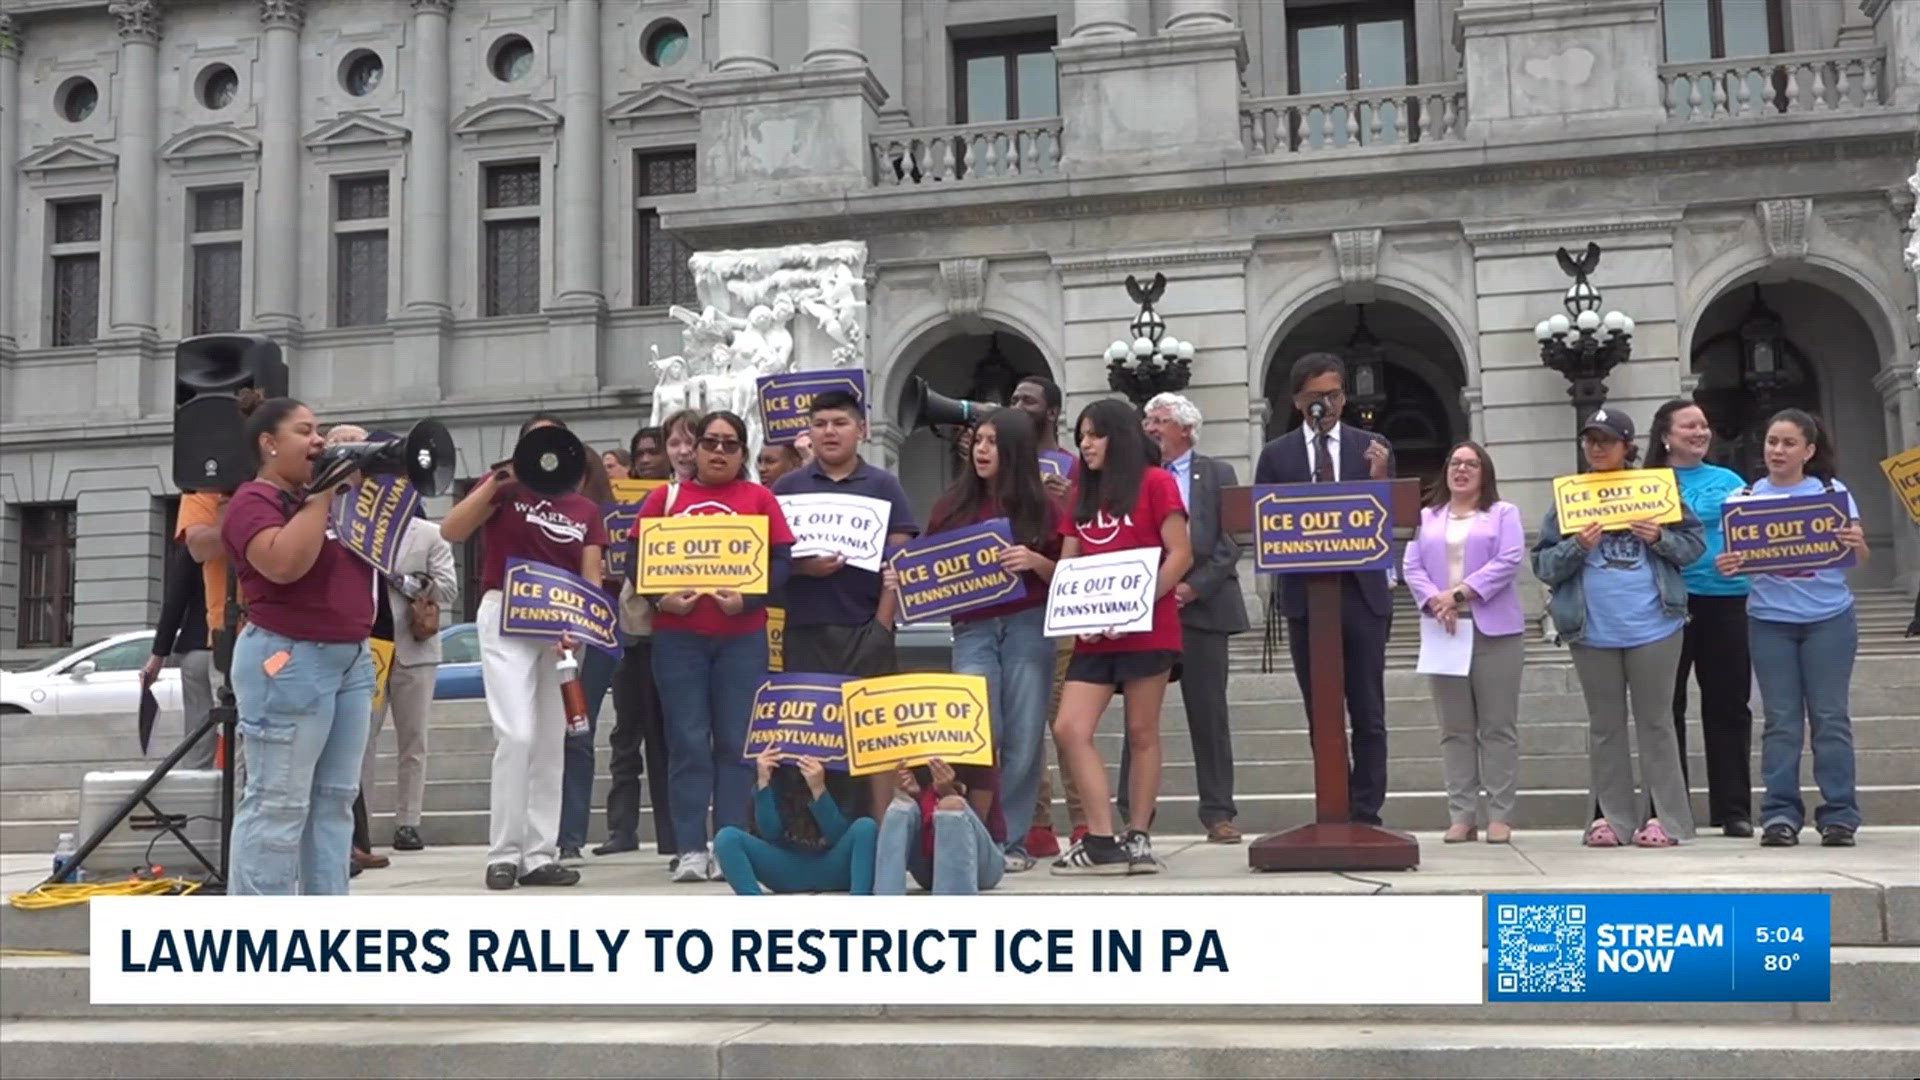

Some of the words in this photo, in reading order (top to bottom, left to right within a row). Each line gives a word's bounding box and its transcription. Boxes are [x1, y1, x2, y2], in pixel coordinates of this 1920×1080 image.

[766, 396, 789, 411] ICE
[355, 477, 379, 518] OUT
[1565, 490, 1591, 504] ICE
[1597, 486, 1633, 500] OUT
[1639, 484, 1661, 495] OF
[1567, 500, 1665, 519] PENNSYLVANIA
[808, 513, 843, 525] OUT
[851, 516, 872, 531] OF
[1263, 514, 1294, 531] ICE
[1300, 511, 1342, 530] OUT
[1348, 510, 1375, 527] OF
[1731, 525, 1760, 541] ICE
[1765, 520, 1805, 539] OUT
[1811, 516, 1836, 534] OF
[351, 519, 367, 550] ICE
[648, 540, 676, 556] ICE
[683, 539, 721, 556] OUT
[728, 540, 753, 555] OF
[1263, 538, 1376, 555] PENNSYLVANIA
[1741, 541, 1839, 560] ENNSYLVANIA
[647, 564, 753, 577] PENNSYLVANIA
[900, 565, 929, 585] ICE
[933, 554, 971, 577] OUT
[976, 546, 1000, 566] OF
[905, 571, 1007, 607] PENNSYLVANIA
[1056, 581, 1079, 596] ICE
[1084, 576, 1116, 594] OUT
[1121, 574, 1142, 590] OF
[512, 581, 543, 599] ICE
[549, 587, 586, 608] OUT
[590, 602, 609, 622] OF
[1053, 601, 1139, 617] PENNSYLVANIA
[510, 606, 611, 640] PENNSYLVANIA
[755, 702, 775, 719] ICE
[779, 701, 817, 720] OUT
[855, 707, 886, 728] ICE
[894, 702, 938, 722] OUT
[946, 703, 971, 719] OF
[751, 730, 844, 748] PENNSYLVANIA
[857, 730, 974, 753] PENNSYLVANIA
